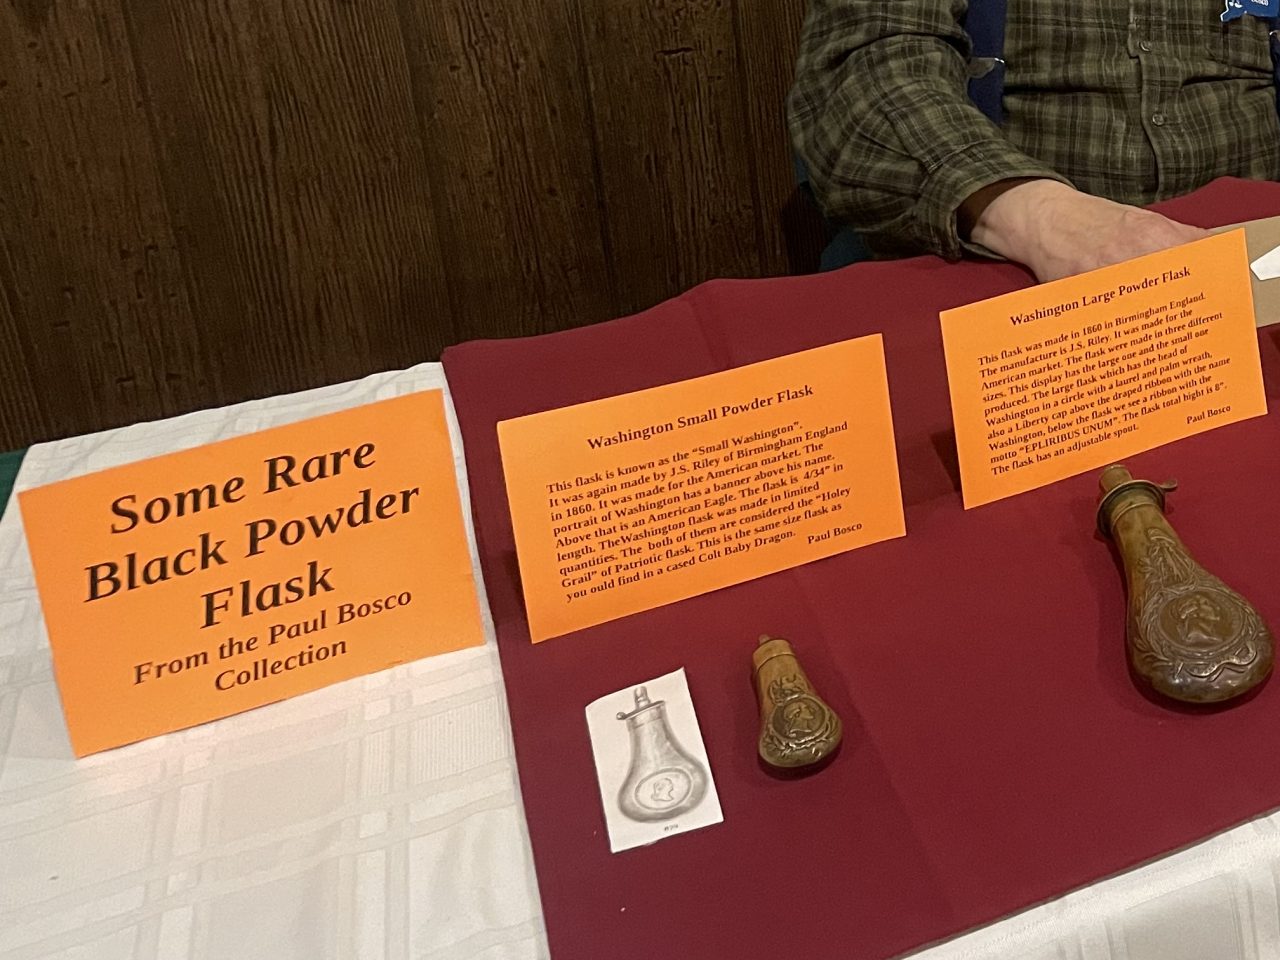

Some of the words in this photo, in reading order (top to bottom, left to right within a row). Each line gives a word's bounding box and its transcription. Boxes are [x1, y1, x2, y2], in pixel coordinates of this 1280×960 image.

[1010, 301, 1079, 325] Washington
[1082, 290, 1115, 306] Large
[1118, 277, 1159, 296] Powder
[1162, 266, 1190, 283] Flask
[977, 354, 999, 366] This
[1000, 346, 1023, 359] flask
[1025, 342, 1043, 352] was
[1044, 333, 1068, 347] made
[1070, 330, 1080, 339] in
[1082, 323, 1102, 336] 1860
[1104, 320, 1113, 329] in
[1115, 305, 1167, 326] Birmingham
[978, 367, 998, 378] The
[1000, 350, 1057, 372] manufacture
[1059, 346, 1067, 355] is
[1114, 330, 1121, 339] It
[1123, 325, 1139, 335] was
[1141, 317, 1163, 330] made
[1165, 313, 1178, 323] for
[1179, 309, 1193, 319] the
[587, 422, 673, 449] Washington
[677, 408, 717, 428] Small
[721, 397, 773, 417] Powder
[776, 384, 813, 403] Flask
[990, 450, 1017, 464] motto
[1121, 411, 1139, 422] The
[1140, 402, 1160, 415] flask
[1162, 395, 1181, 408] total
[1205, 385, 1213, 394] is
[1186, 411, 1205, 424] Paul
[1206, 405, 1231, 418] Bosco
[545, 480, 572, 494] This
[575, 472, 603, 487] flask
[605, 470, 615, 479] is
[617, 461, 655, 476] known
[657, 457, 670, 466] as
[672, 452, 689, 462] the
[549, 498, 559, 508] It
[561, 493, 584, 504] was
[586, 484, 617, 499] again
[620, 474, 650, 489] made
[652, 471, 667, 481] by
[692, 457, 720, 470] Riley
[723, 451, 734, 462] of
[736, 436, 802, 459] Birmingham
[805, 421, 847, 440] England
[550, 512, 563, 522] in
[566, 503, 595, 518] 1860.
[597, 497, 608, 509] It
[610, 494, 632, 505] was
[634, 480, 665, 499] made
[667, 480, 684, 491] for
[686, 475, 704, 486] the
[706, 461, 758, 481] American
[802, 443, 823, 454] The
[990, 465, 1010, 475] The
[1012, 456, 1034, 470] flask
[1035, 452, 1052, 462] has
[1053, 448, 1065, 456] an
[1066, 431, 1111, 452] adjustable
[1113, 423, 1138, 438] spout.
[111, 477, 244, 533] Some
[264, 443, 375, 493] Rare
[553, 515, 598, 537] portrait
[601, 510, 612, 522] of
[614, 496, 680, 518] Washington
[682, 489, 702, 500] has
[704, 487, 711, 495] a
[713, 476, 751, 492] banner
[754, 467, 784, 481] above
[786, 461, 802, 472] his
[804, 454, 835, 467] name.
[555, 533, 591, 548] Above
[594, 525, 617, 538] that
[619, 521, 629, 531] is
[631, 518, 646, 528] an
[648, 503, 701, 523] American
[703, 493, 737, 508] Eagle.
[738, 487, 760, 498] The
[762, 478, 788, 492] flask
[789, 475, 799, 484] is
[833, 463, 843, 472] in
[85, 533, 226, 601] Black
[246, 488, 418, 556] Powder
[807, 529, 830, 544] Paul
[833, 523, 862, 537] Bosco
[201, 561, 333, 628] Flask
[134, 651, 208, 684] From
[219, 636, 258, 659] the
[268, 609, 326, 645] Paul
[337, 591, 411, 624] Bosco
[215, 641, 346, 690] Collection
